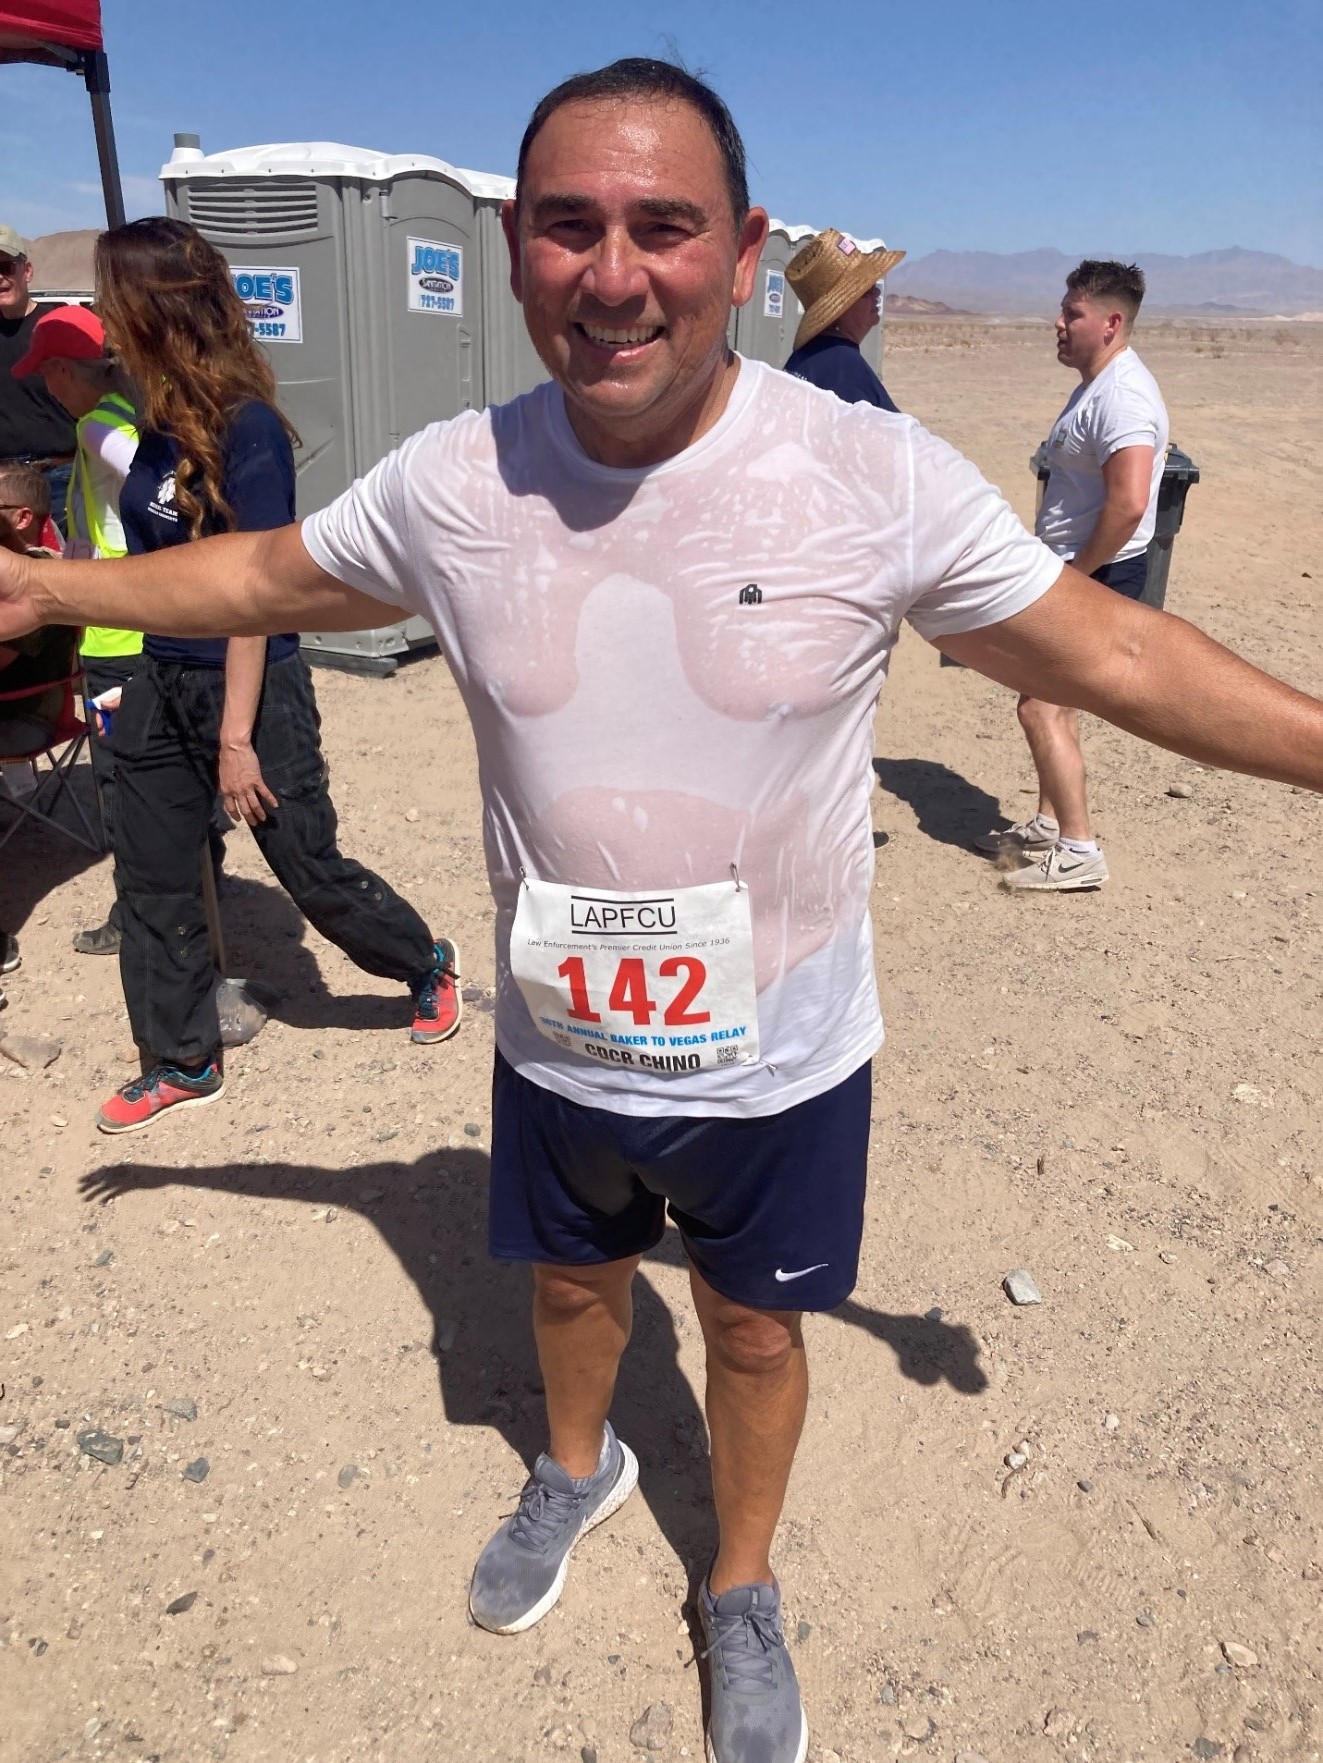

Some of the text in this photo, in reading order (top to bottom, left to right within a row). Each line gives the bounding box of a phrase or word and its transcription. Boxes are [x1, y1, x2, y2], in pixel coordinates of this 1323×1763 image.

[412, 246, 460, 281] JOE'S
[231, 273, 294, 305] OE'S
[249, 322, 286, 336] 7-5587
[571, 904, 676, 928] LAPFCU
[527, 938, 541, 947] Law
[544, 941, 597, 951] Enforcement's
[685, 941, 707, 950] Since
[710, 937, 730, 947] 1936
[557, 956, 711, 1026] 142
[567, 1024, 607, 1041] ANNUAL
[610, 1033, 648, 1045] BAKER
[651, 1036, 666, 1046] TO
[669, 1034, 707, 1046] VEGAS
[711, 1026, 746, 1041] RELAY
[639, 1053, 701, 1072] CHINO
